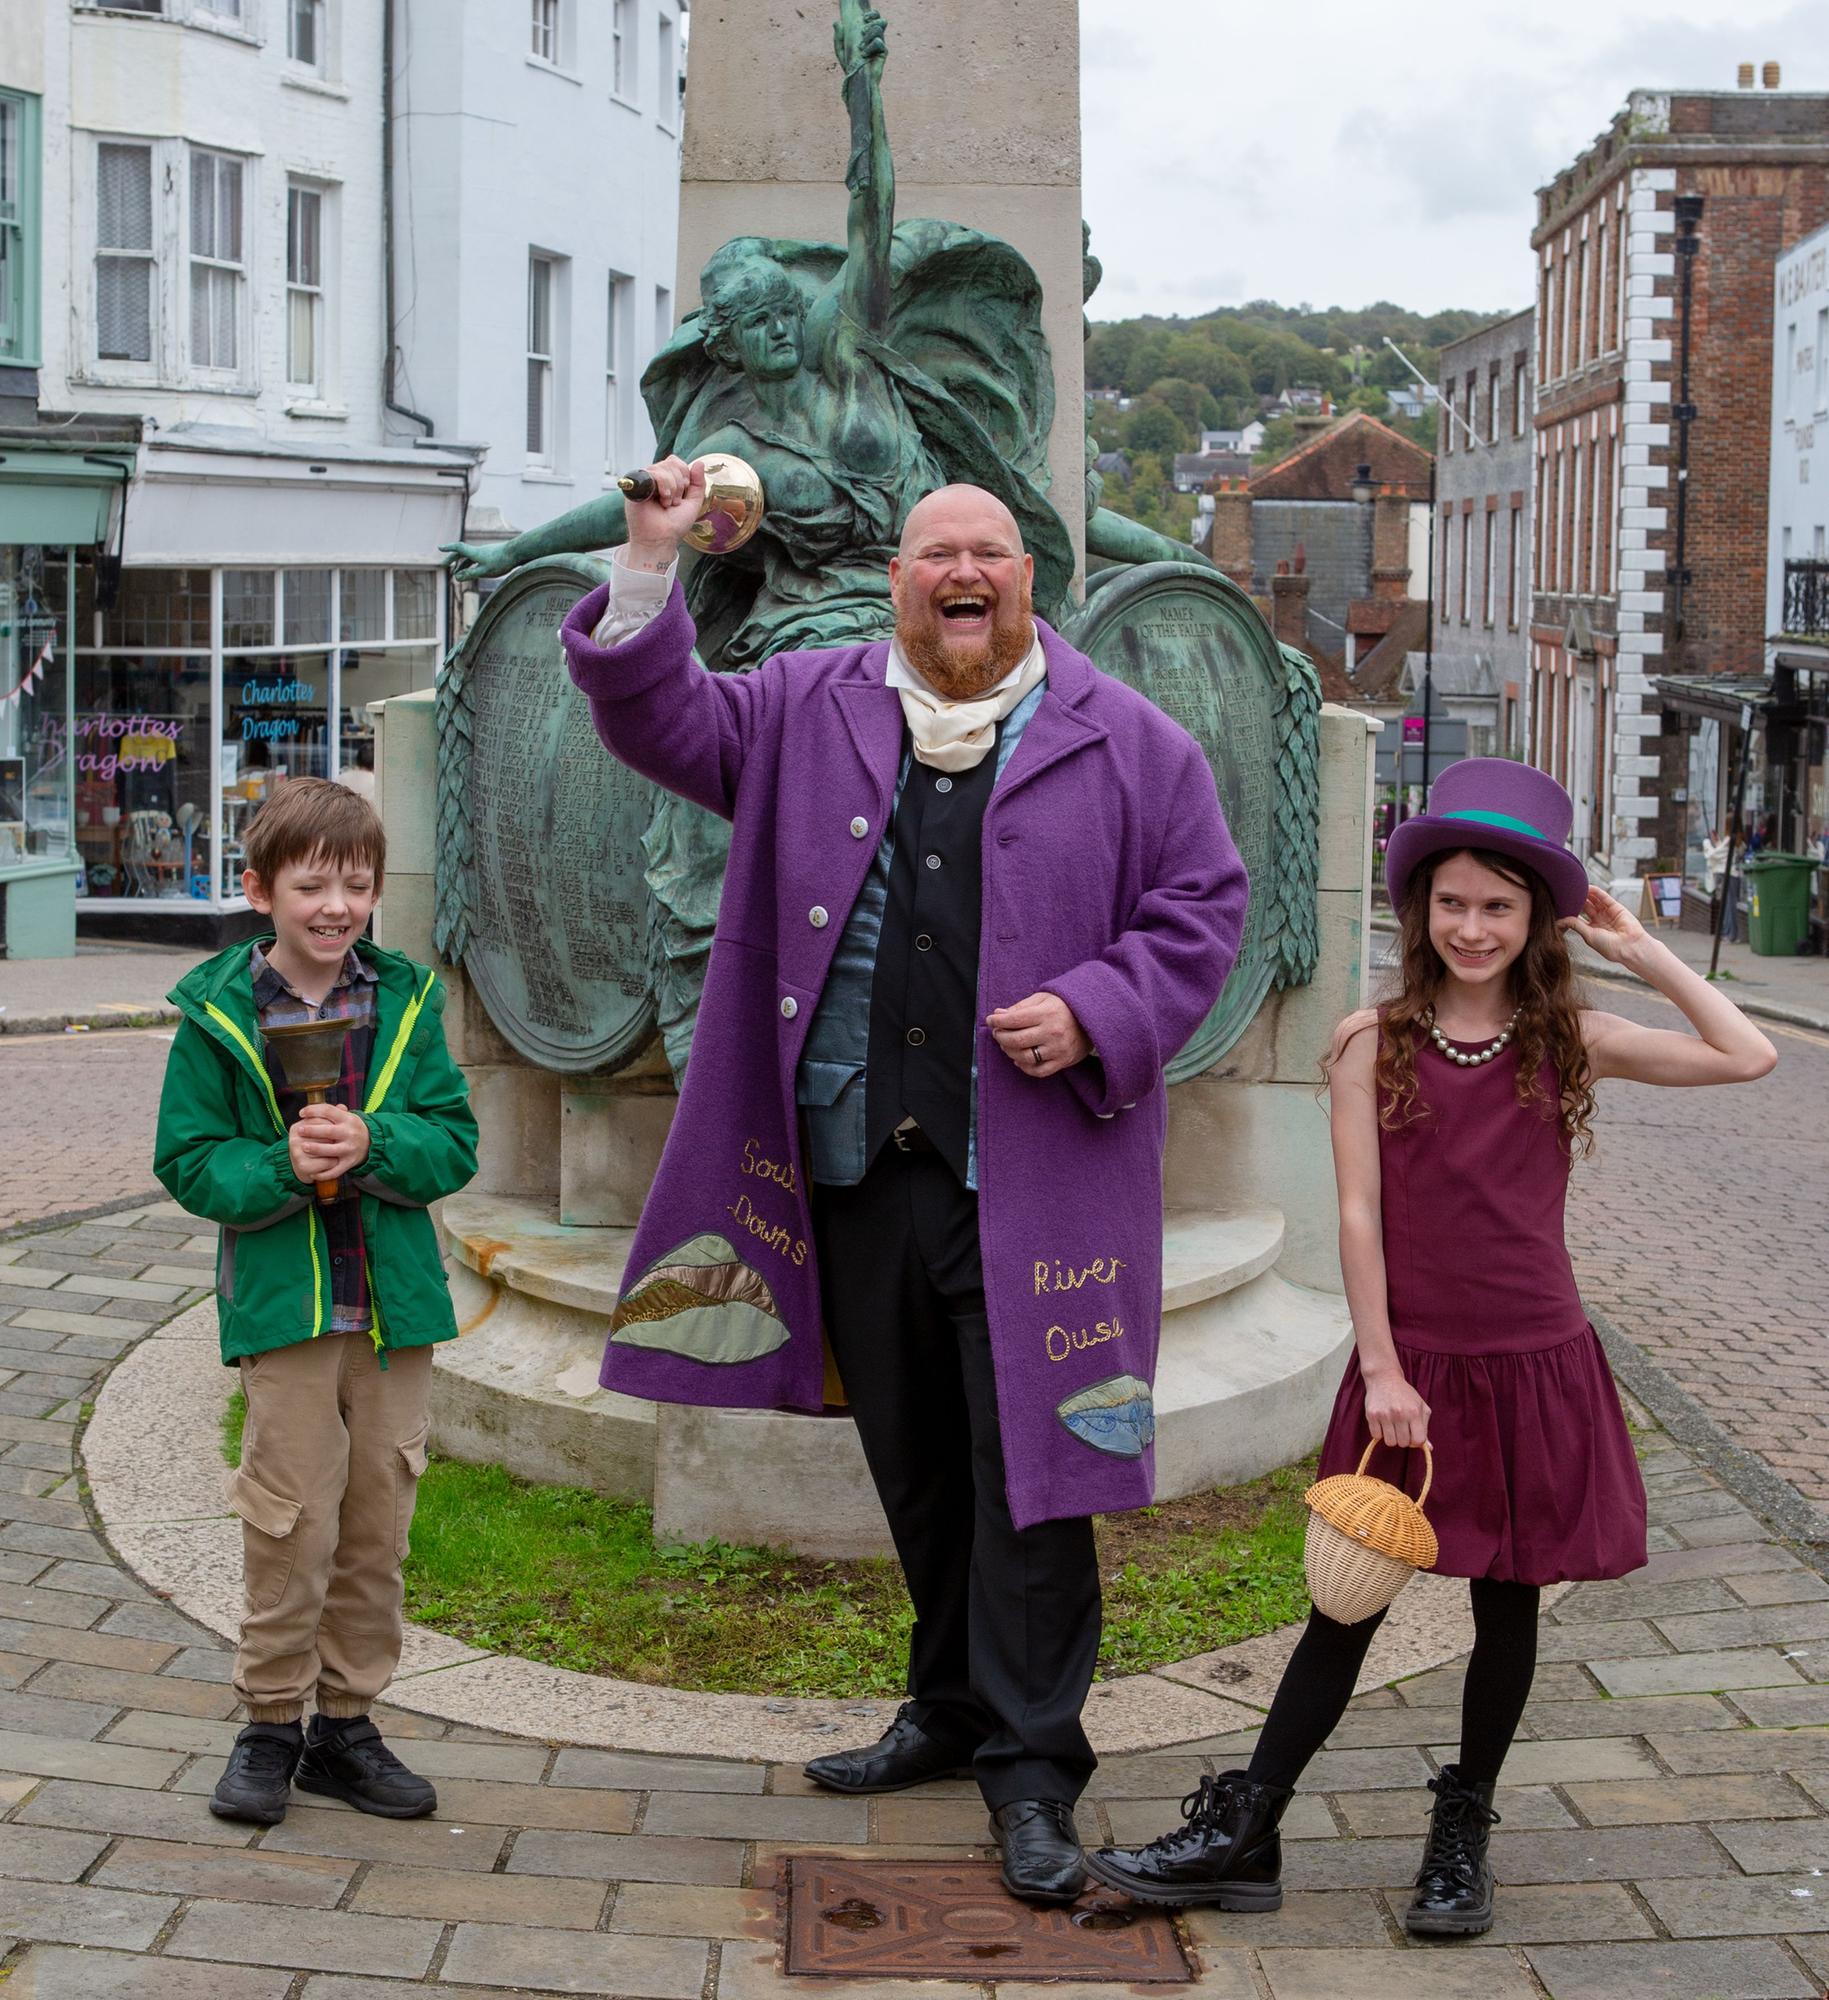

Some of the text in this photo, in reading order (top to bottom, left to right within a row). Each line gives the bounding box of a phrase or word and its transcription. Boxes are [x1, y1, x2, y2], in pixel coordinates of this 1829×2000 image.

[1159, 607, 1194, 621] NAMES
[1141, 624, 1214, 639] OF THE FALLEN
[241, 677, 315, 706] Charlottes
[40, 711, 184, 740] harlottes
[241, 716, 300, 746] Dragon
[38, 738, 166, 781] Dagon
[727, 1194, 807, 1266] Downs
[1034, 1257, 1127, 1295] River
